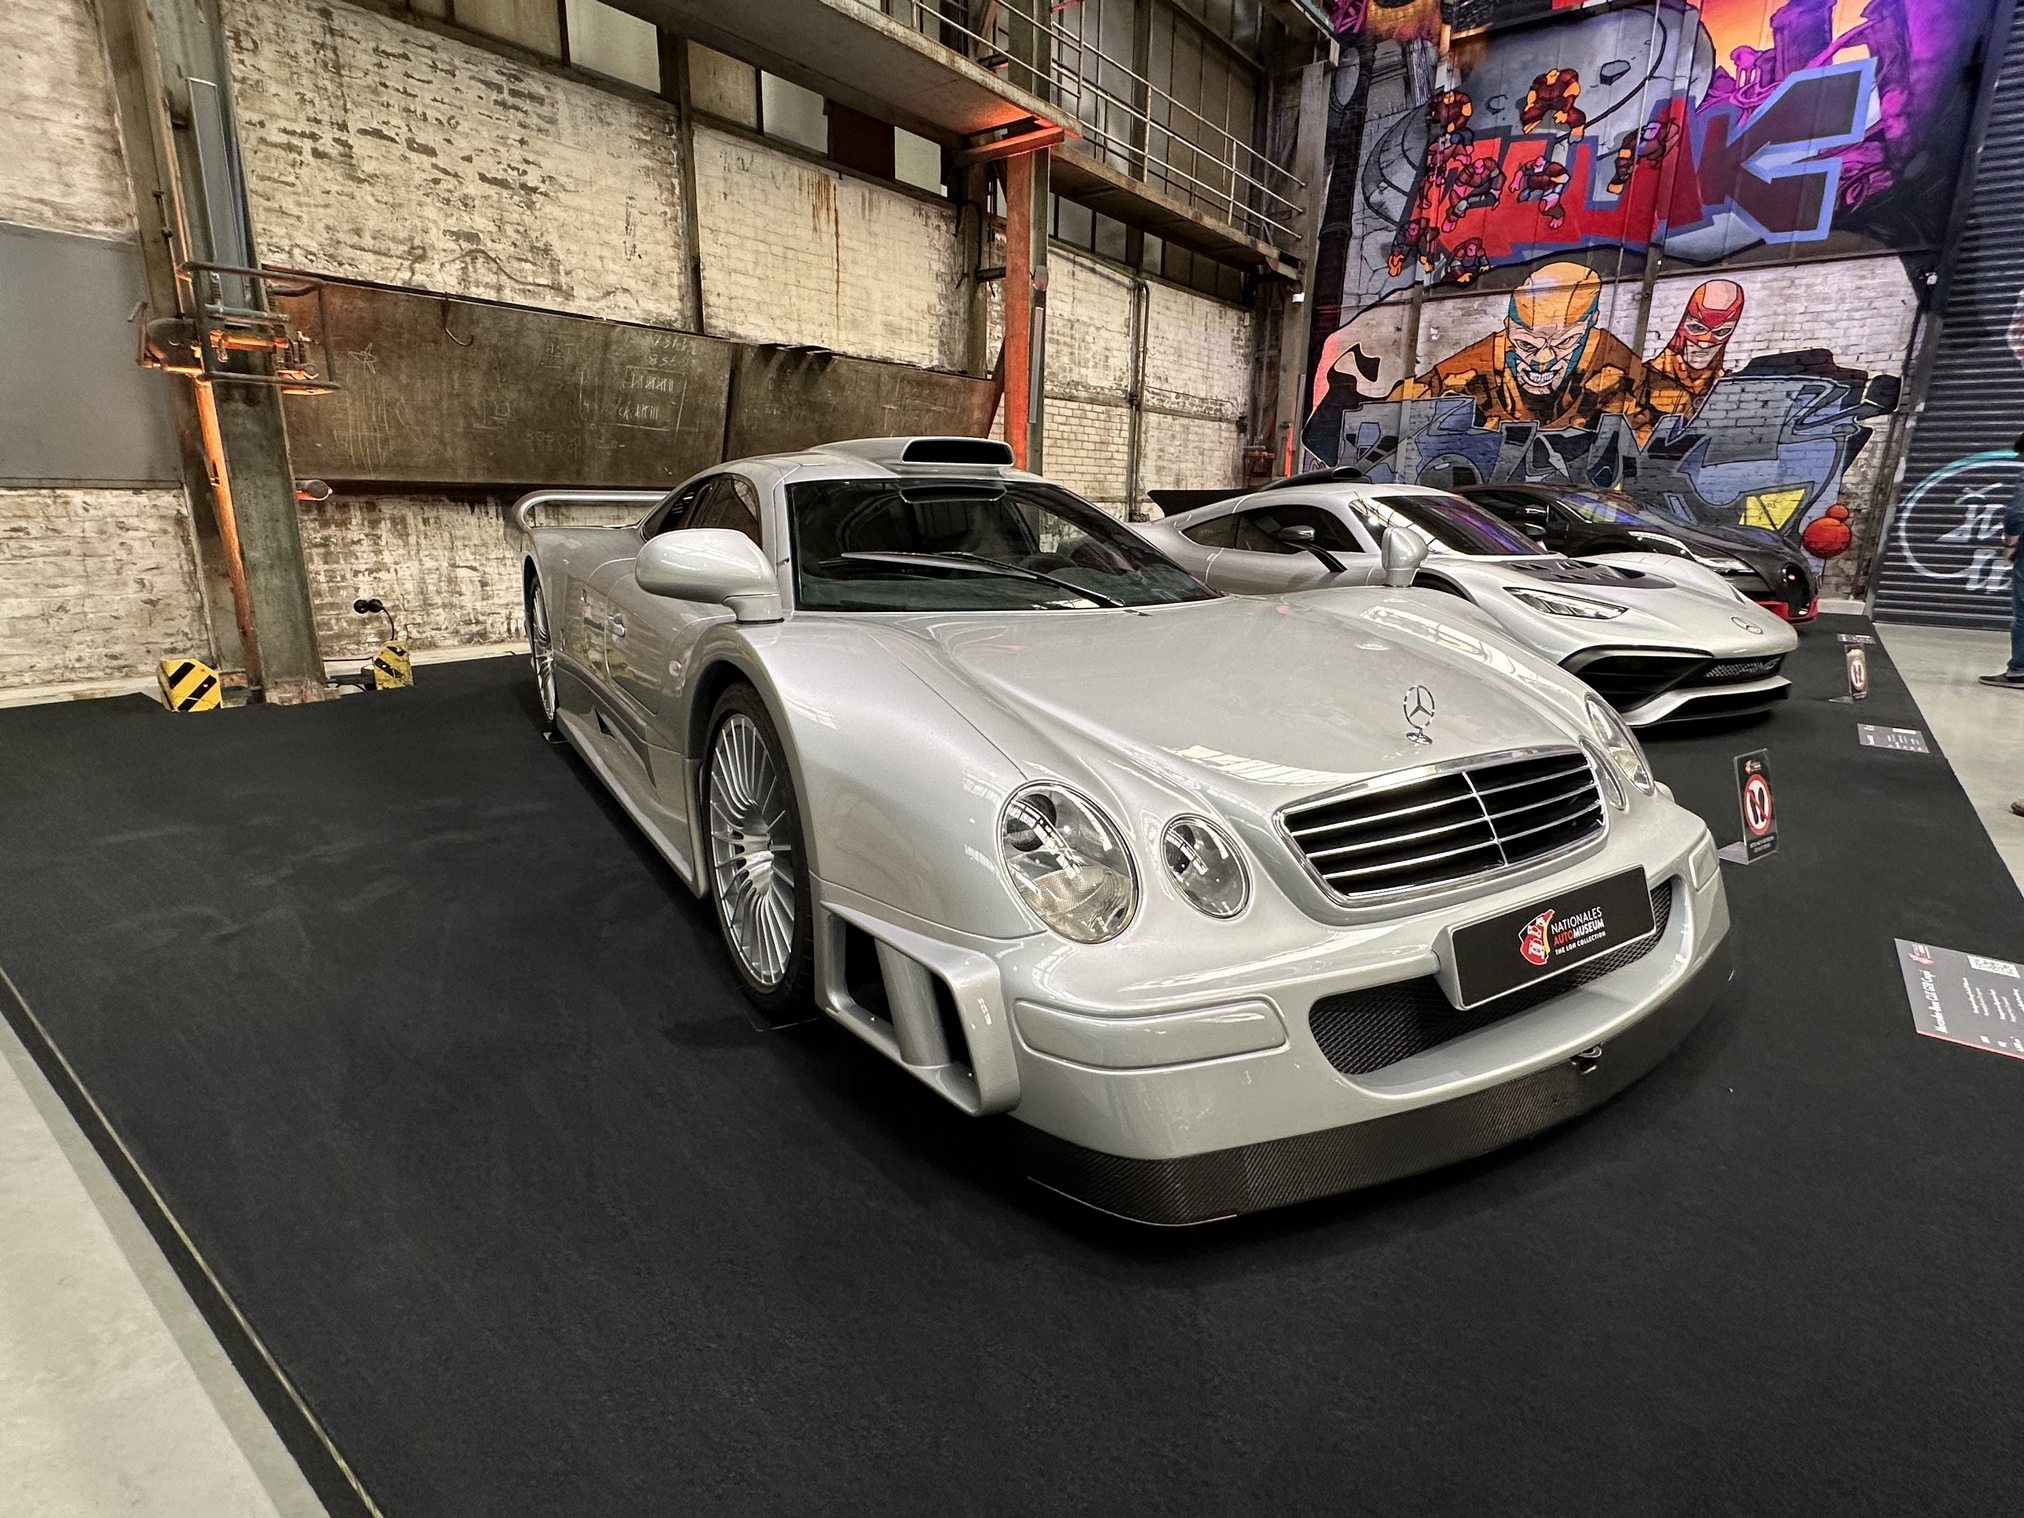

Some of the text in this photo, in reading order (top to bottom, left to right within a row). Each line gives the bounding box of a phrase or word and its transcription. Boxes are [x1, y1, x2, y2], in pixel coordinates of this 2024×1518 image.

[1550, 906, 1602, 935] NATIONALES
[1554, 918, 1604, 946] AUTOMUSEUM
[1555, 947, 1565, 955] THE
[1577, 930, 1606, 947] COLLECTION
